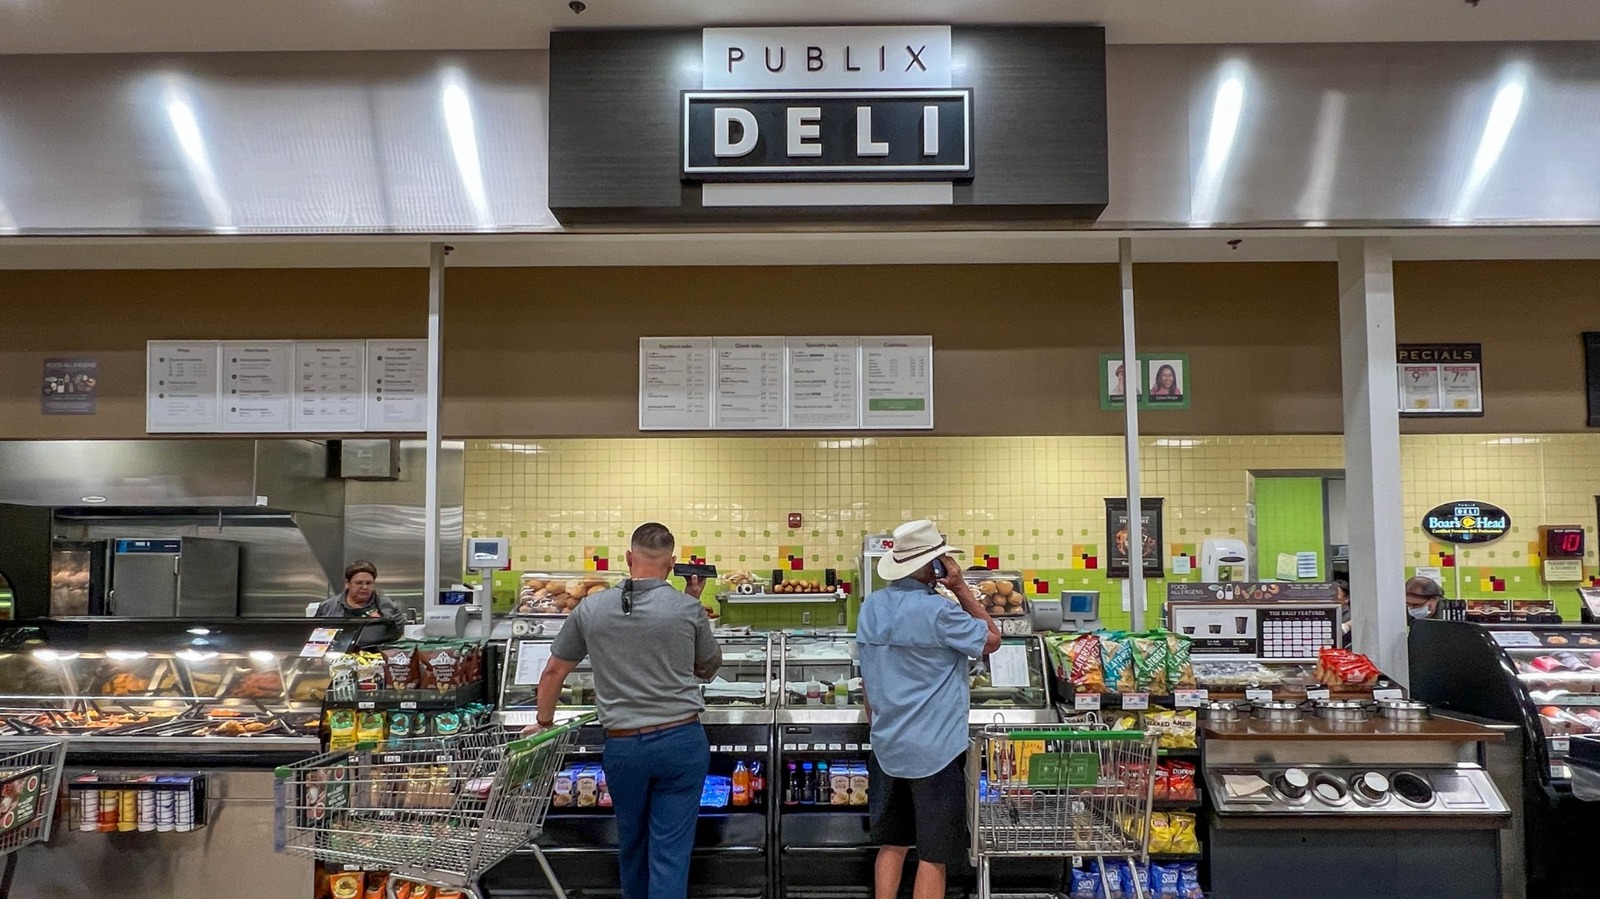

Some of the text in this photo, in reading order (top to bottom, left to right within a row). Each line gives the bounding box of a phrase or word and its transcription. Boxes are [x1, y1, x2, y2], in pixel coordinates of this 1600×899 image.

[727, 45, 926, 74] PUBLIX
[714, 105, 939, 158] DELI
[1400, 350, 1473, 360] PECIALS
[1428, 516, 1506, 528] Boar's Head
[1562, 534, 1580, 551] 10
[1173, 719, 1192, 727] AKED
